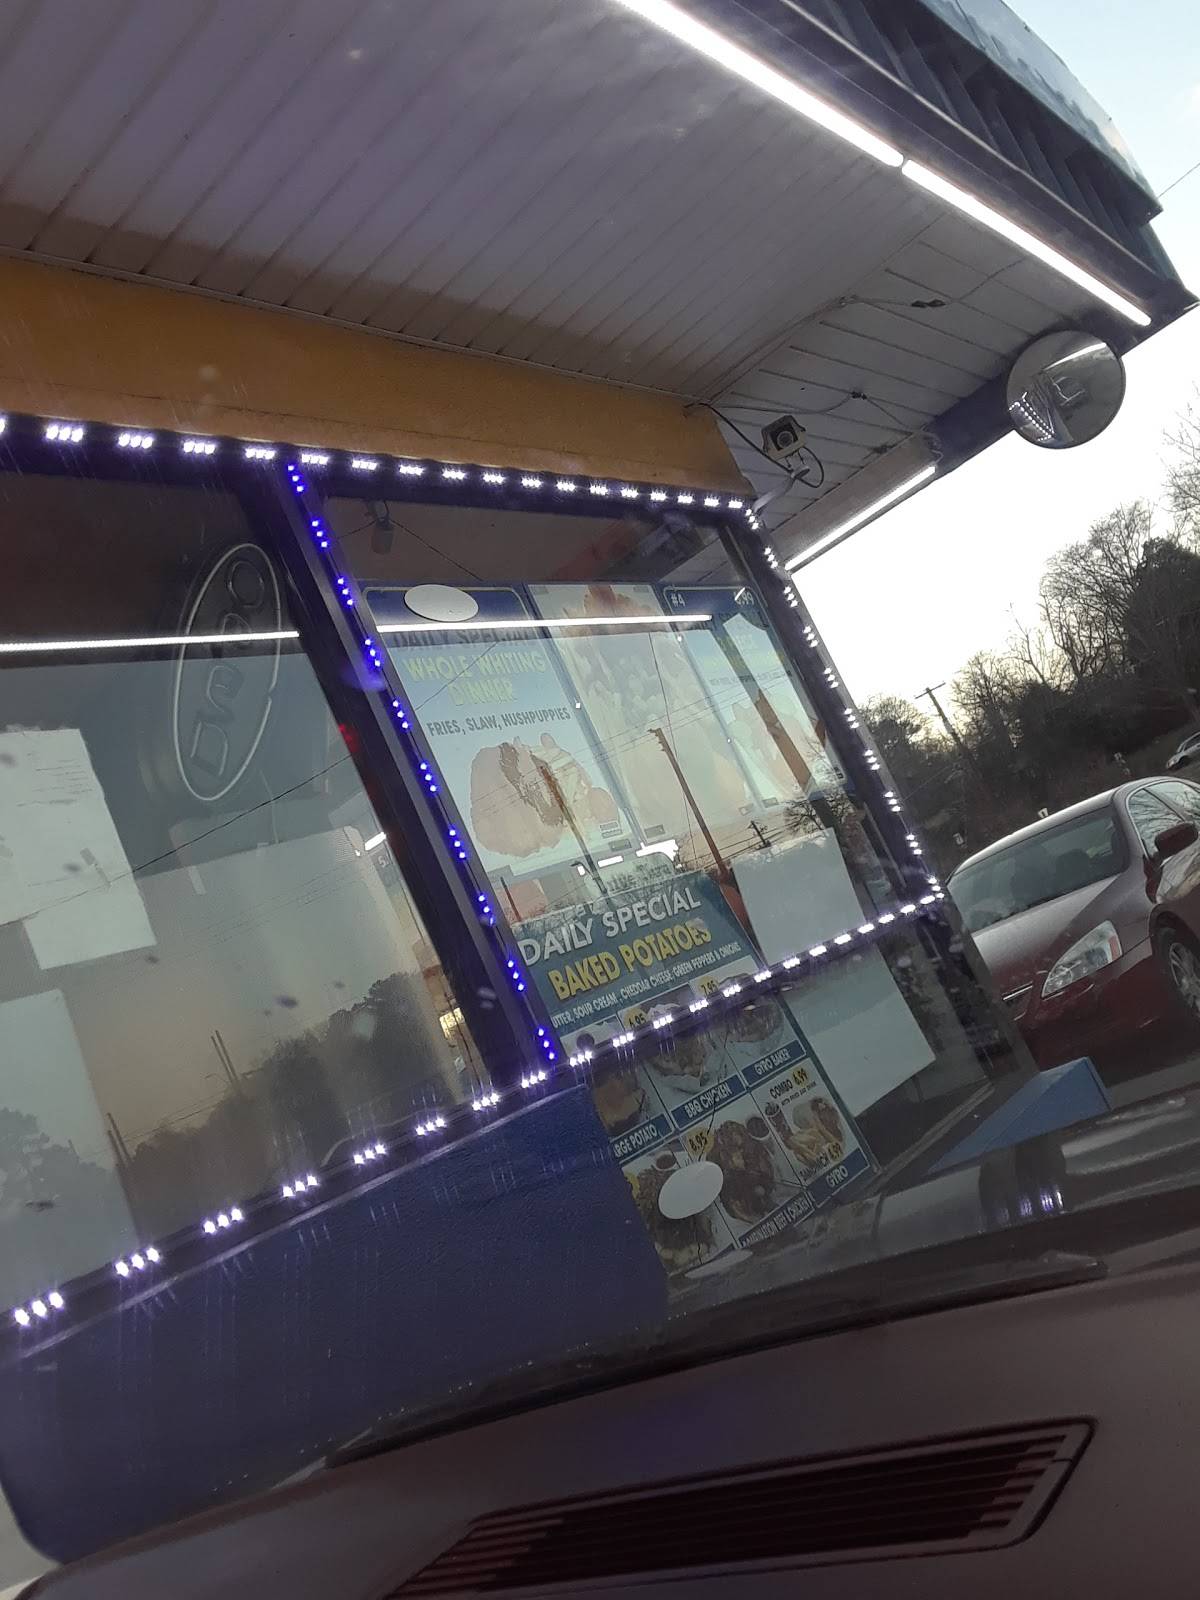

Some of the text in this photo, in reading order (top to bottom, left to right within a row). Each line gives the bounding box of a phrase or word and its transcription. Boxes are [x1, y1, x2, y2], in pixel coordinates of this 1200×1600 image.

[671, 593, 686, 607] #4
[402, 650, 546, 683] WHOLE WHITING
[427, 707, 572, 737] FRIES, SLAW, HUSHPUPPIES
[517, 887, 702, 966] DAILY SPECIAL
[549, 919, 712, 1001] BAKED POTATOES
[551, 1011, 576, 1029] UTTER,
[573, 1002, 594, 1018] SOUR
[593, 993, 620, 1011] CREAM
[620, 980, 651, 998] CHEDDAR
[672, 961, 693, 977] GREEN
[691, 951, 716, 970] PEPPERS
[754, 1048, 792, 1076] GYRO BAKER
[684, 1081, 733, 1119] BBQ CHICKEN
[769, 1078, 794, 1100] COMBO
[630, 1124, 659, 1148] POTATO
[825, 1164, 849, 1188] GYRO
